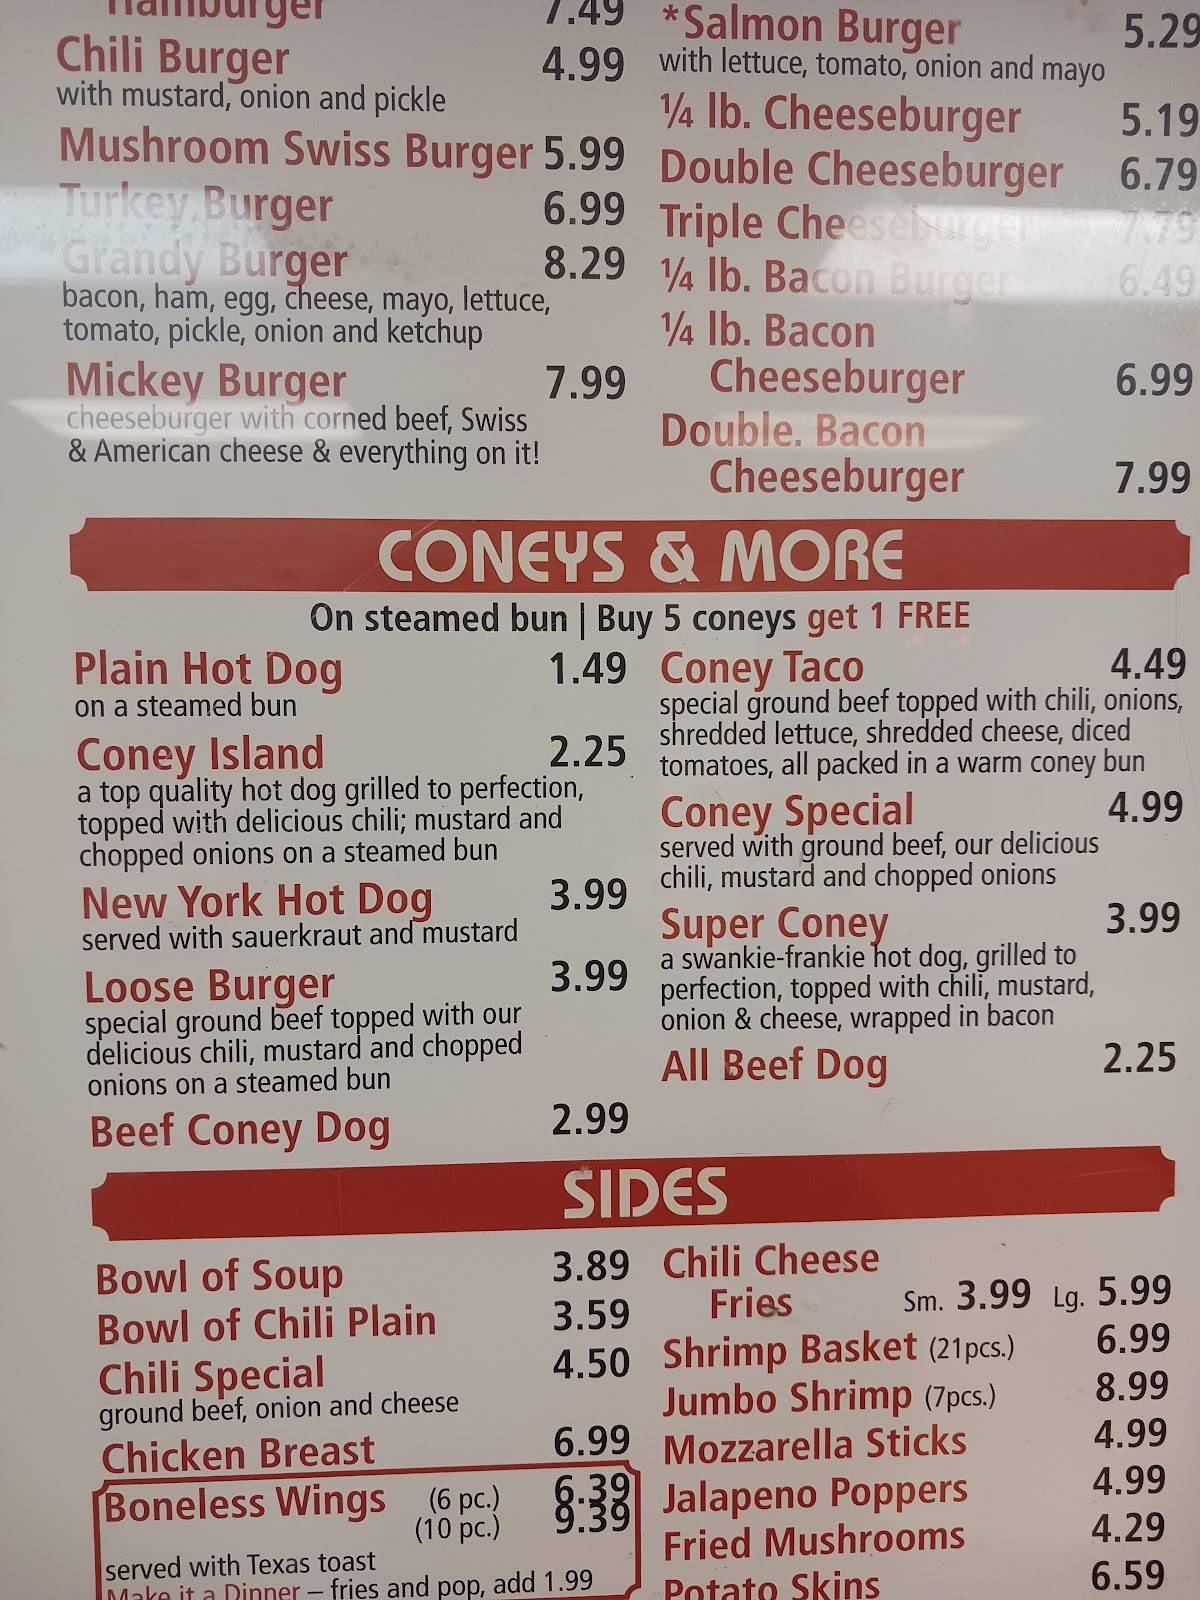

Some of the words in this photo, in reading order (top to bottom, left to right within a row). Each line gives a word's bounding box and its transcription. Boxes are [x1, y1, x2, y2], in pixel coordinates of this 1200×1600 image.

[839, 8, 961, 54] Burger
[1124, 12, 1200, 48] 5.29
[57, 34, 143, 73] Chili
[159, 38, 290, 83] Burger
[542, 46, 625, 82] 4.99
[659, 46, 712, 72] with
[722, 46, 808, 78] lettuce,
[816, 52, 907, 80] tomato,
[916, 53, 981, 78] onion
[990, 54, 1033, 80] and
[1042, 60, 1105, 88] mayo
[56, 80, 112, 106] with
[122, 81, 230, 111] mustard,
[240, 83, 310, 109] onion
[320, 84, 365, 110] and
[375, 85, 446, 118] pickle
[708, 92, 750, 128] lb.
[765, 93, 1021, 142] Cheeseburger
[1121, 102, 1199, 137] 5.19
[60, 126, 269, 165] Mushroom
[284, 130, 390, 167] Swiss
[406, 133, 534, 178] Burger
[544, 136, 624, 171] 5.99
[662, 148, 793, 184] Double
[808, 150, 1064, 197] Cheeseburger
[1121, 156, 1197, 191] 6.79
[67, 361, 204, 404] Mickey
[218, 363, 346, 405] Burger
[546, 365, 626, 400] 7.99
[710, 357, 965, 403] Cheeseburger
[1116, 363, 1193, 396] 6.99
[68, 438, 87, 462] &
[94, 437, 210, 464] American
[220, 436, 302, 463] cheese
[313, 439, 331, 463] &
[340, 438, 467, 471] everything
[476, 446, 505, 465] on
[516, 440, 539, 465] it!
[710, 457, 965, 502] Cheeseburger
[1116, 461, 1190, 494] 7.99
[379, 530, 624, 584] CONEYS
[649, 530, 699, 583] &
[719, 528, 904, 582] MORE
[310, 603, 353, 631] On
[365, 602, 499, 632] steamed
[512, 602, 568, 632] bun
[598, 604, 653, 640] Buy
[665, 604, 681, 632] 5
[693, 609, 796, 638] coneys
[808, 604, 858, 638] get
[872, 602, 882, 628] 1
[898, 602, 969, 628] FREE
[76, 649, 168, 685] Plain
[184, 651, 252, 684] Hot
[266, 652, 341, 694] Dog
[550, 651, 626, 684] 1.49
[662, 651, 772, 691] Coney
[783, 650, 864, 682] Taco
[1111, 648, 1186, 680] 4.49
[76, 699, 104, 717] on
[114, 699, 128, 717] a
[136, 691, 242, 717] steamed
[252, 691, 296, 716] bun
[660, 690, 738, 721] special
[748, 689, 829, 720] ground
[838, 688, 890, 712] beef
[896, 688, 978, 718] topped
[986, 687, 1036, 712] with
[1045, 686, 1096, 714] chili,
[1104, 688, 1183, 714] onions,
[78, 738, 196, 780] Coney
[211, 734, 323, 770] Island
[550, 735, 626, 768] 2.25
[78, 785, 91, 803] a
[100, 781, 140, 809] top
[150, 777, 232, 808] quality
[242, 776, 283, 802] hot
[291, 776, 336, 807] dog
[346, 775, 418, 806] grilled
[428, 779, 451, 802] to
[460, 774, 584, 806] perfection,
[662, 796, 772, 836] Coney
[786, 791, 912, 834] Special
[1108, 791, 1183, 822] 4.99
[83, 887, 168, 919] New
[178, 882, 264, 917] York
[279, 884, 344, 916] Hot
[359, 882, 432, 922] Dog
[551, 878, 627, 911] 3.99
[662, 908, 764, 947] Super
[778, 907, 888, 946] Coney
[1107, 902, 1180, 934] 3.99
[86, 972, 194, 1004] Loose
[210, 966, 336, 1008] Burger
[551, 960, 628, 992] 3.99
[661, 1048, 708, 1082] All
[724, 1046, 804, 1080] Beef
[818, 1048, 886, 1088] Dog
[1104, 1042, 1176, 1074] 2.25
[92, 1112, 174, 1148] Beef
[188, 1114, 302, 1152] Coney
[317, 1111, 390, 1150] Dog
[553, 1102, 628, 1136] 2.99
[563, 1167, 728, 1220] SIDES
[97, 1260, 186, 1295] Bowl
[202, 1258, 240, 1292] of
[253, 1259, 343, 1298] Soup
[554, 1250, 630, 1282] 3.89
[664, 1244, 740, 1278] Chili
[755, 1243, 880, 1276] Cheese
[711, 1286, 792, 1319] Fries
[904, 1290, 943, 1312] Sm.
[957, 1278, 1031, 1310] 3.99
[1054, 1286, 1084, 1314] Lg.
[1098, 1274, 1172, 1306] 5.99
[98, 1310, 188, 1346] Bowl
[204, 1307, 240, 1342] of
[254, 1306, 333, 1340] Chili
[349, 1304, 436, 1337] Plain
[554, 1298, 630, 1332] 3.59
[664, 1336, 787, 1374] Shrimp
[802, 1330, 918, 1364] Basket
[930, 1334, 1014, 1364] (21pcs.)
[1097, 1323, 1170, 1354] 6.99
[100, 1360, 179, 1396] Chili
[194, 1354, 324, 1398] Special
[553, 1348, 630, 1380] 4.50
[662, 1382, 776, 1418] Jumbo
[790, 1379, 912, 1417] Shrimp
[925, 1382, 996, 1414] (7pcs.)
[1096, 1370, 1168, 1402] 8.99
[102, 1439, 244, 1474] Chicken
[260, 1436, 375, 1468] Breast
[554, 1424, 630, 1457] 6.99
[664, 1428, 852, 1465] Mozzarella
[866, 1424, 966, 1458] Sticks
[1094, 1418, 1167, 1448] 4.99
[662, 1480, 817, 1520] Jalapeno
[832, 1478, 968, 1514] Poppers
[1092, 1464, 1166, 1496] 4.99
[664, 1527, 750, 1562] Fried
[766, 1523, 965, 1558] Mushrooms
[1092, 1512, 1165, 1542] 4.29
[106, 1555, 181, 1582] served
[188, 1553, 240, 1578] with
[246, 1554, 310, 1576] Texas
[318, 1552, 376, 1573] toast
